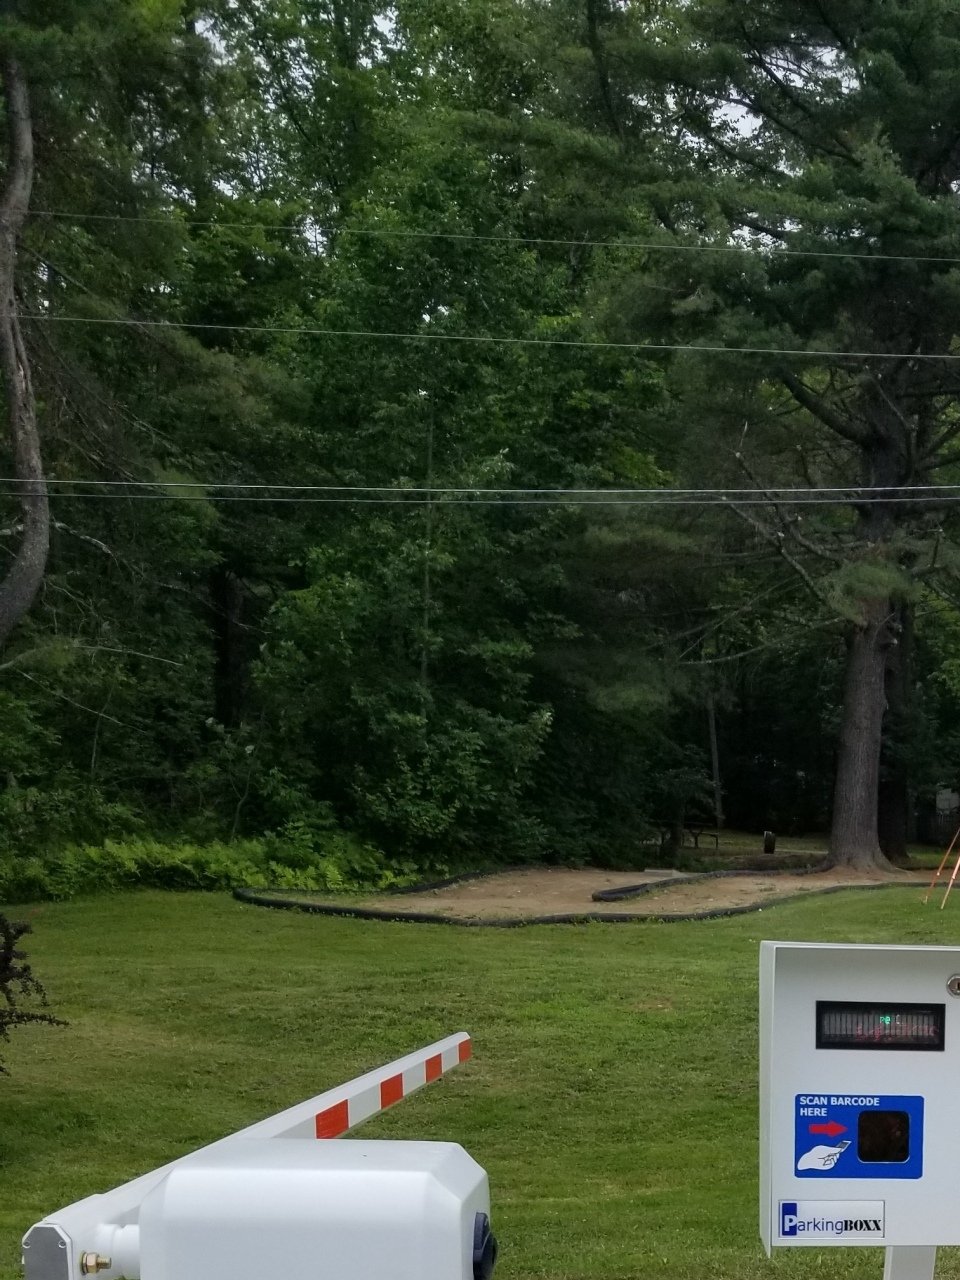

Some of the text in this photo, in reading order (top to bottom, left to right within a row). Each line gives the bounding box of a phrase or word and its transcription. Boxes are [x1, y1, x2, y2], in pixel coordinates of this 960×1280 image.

[800, 1096, 880, 1107] SCAN BARCODE
[800, 1107, 828, 1117] HERE
[783, 1213, 882, 1235] ParkingBOXX
